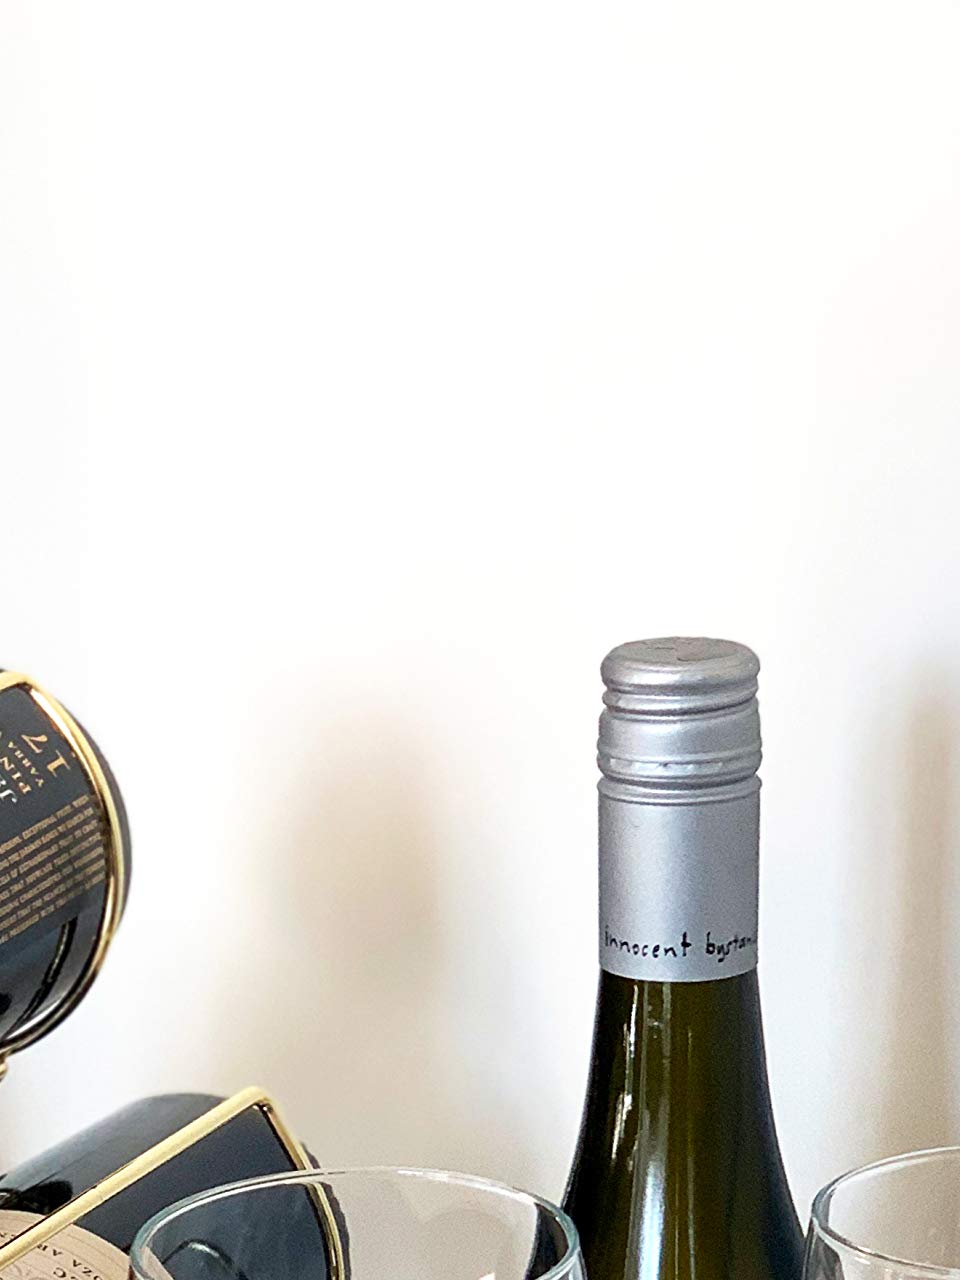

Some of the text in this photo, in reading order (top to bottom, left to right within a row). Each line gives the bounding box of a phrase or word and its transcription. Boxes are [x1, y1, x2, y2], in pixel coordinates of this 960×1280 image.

[7, 740, 44, 787] YARRA
[21, 733, 71, 778] 17
[604, 924, 692, 959] innocent
